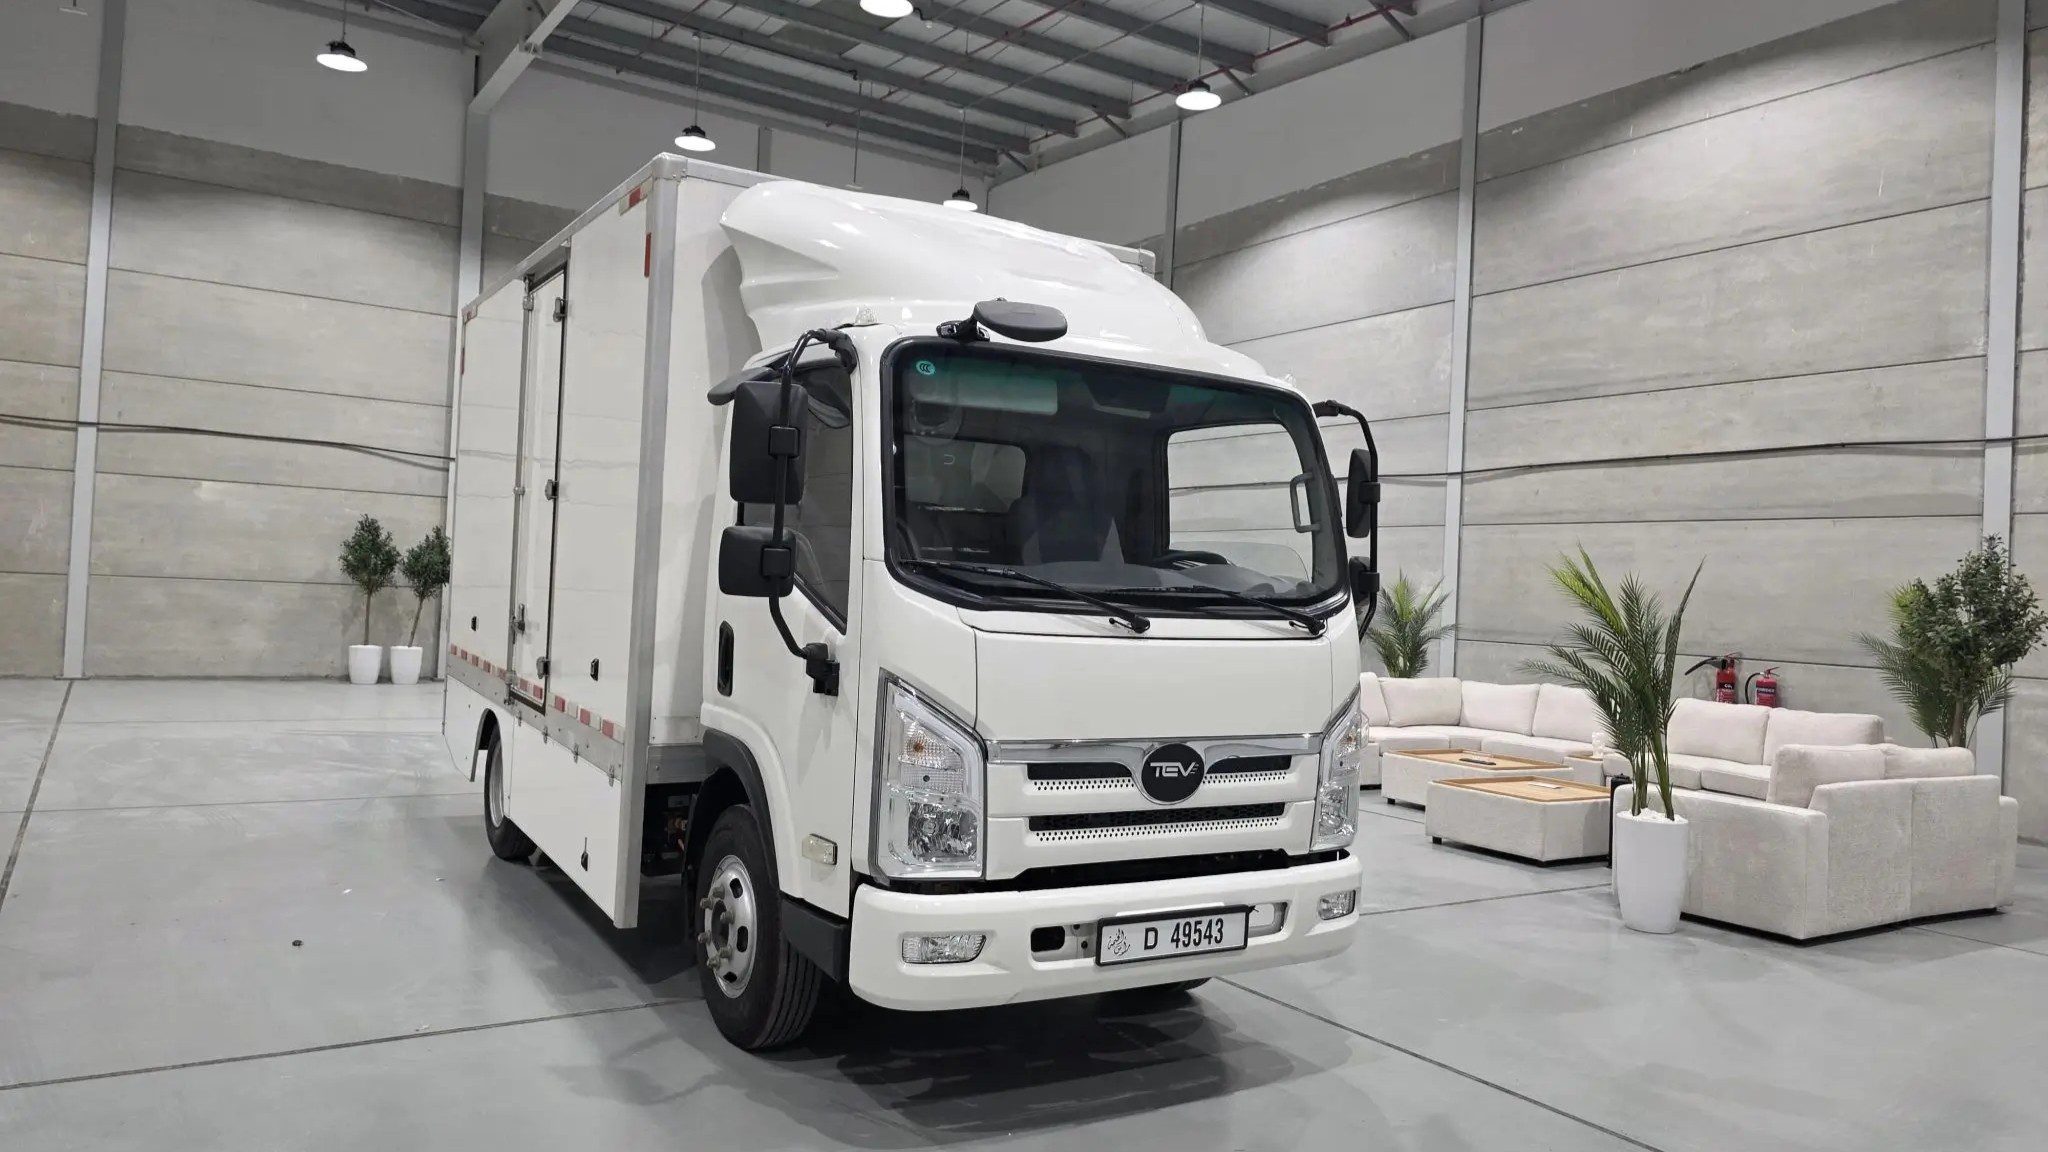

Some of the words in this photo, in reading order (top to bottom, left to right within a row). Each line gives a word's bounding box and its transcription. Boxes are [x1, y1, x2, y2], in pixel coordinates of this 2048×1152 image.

[1150, 762, 1196, 777] TEV
[1144, 927, 1158, 950] D
[1171, 918, 1224, 949] 49543
